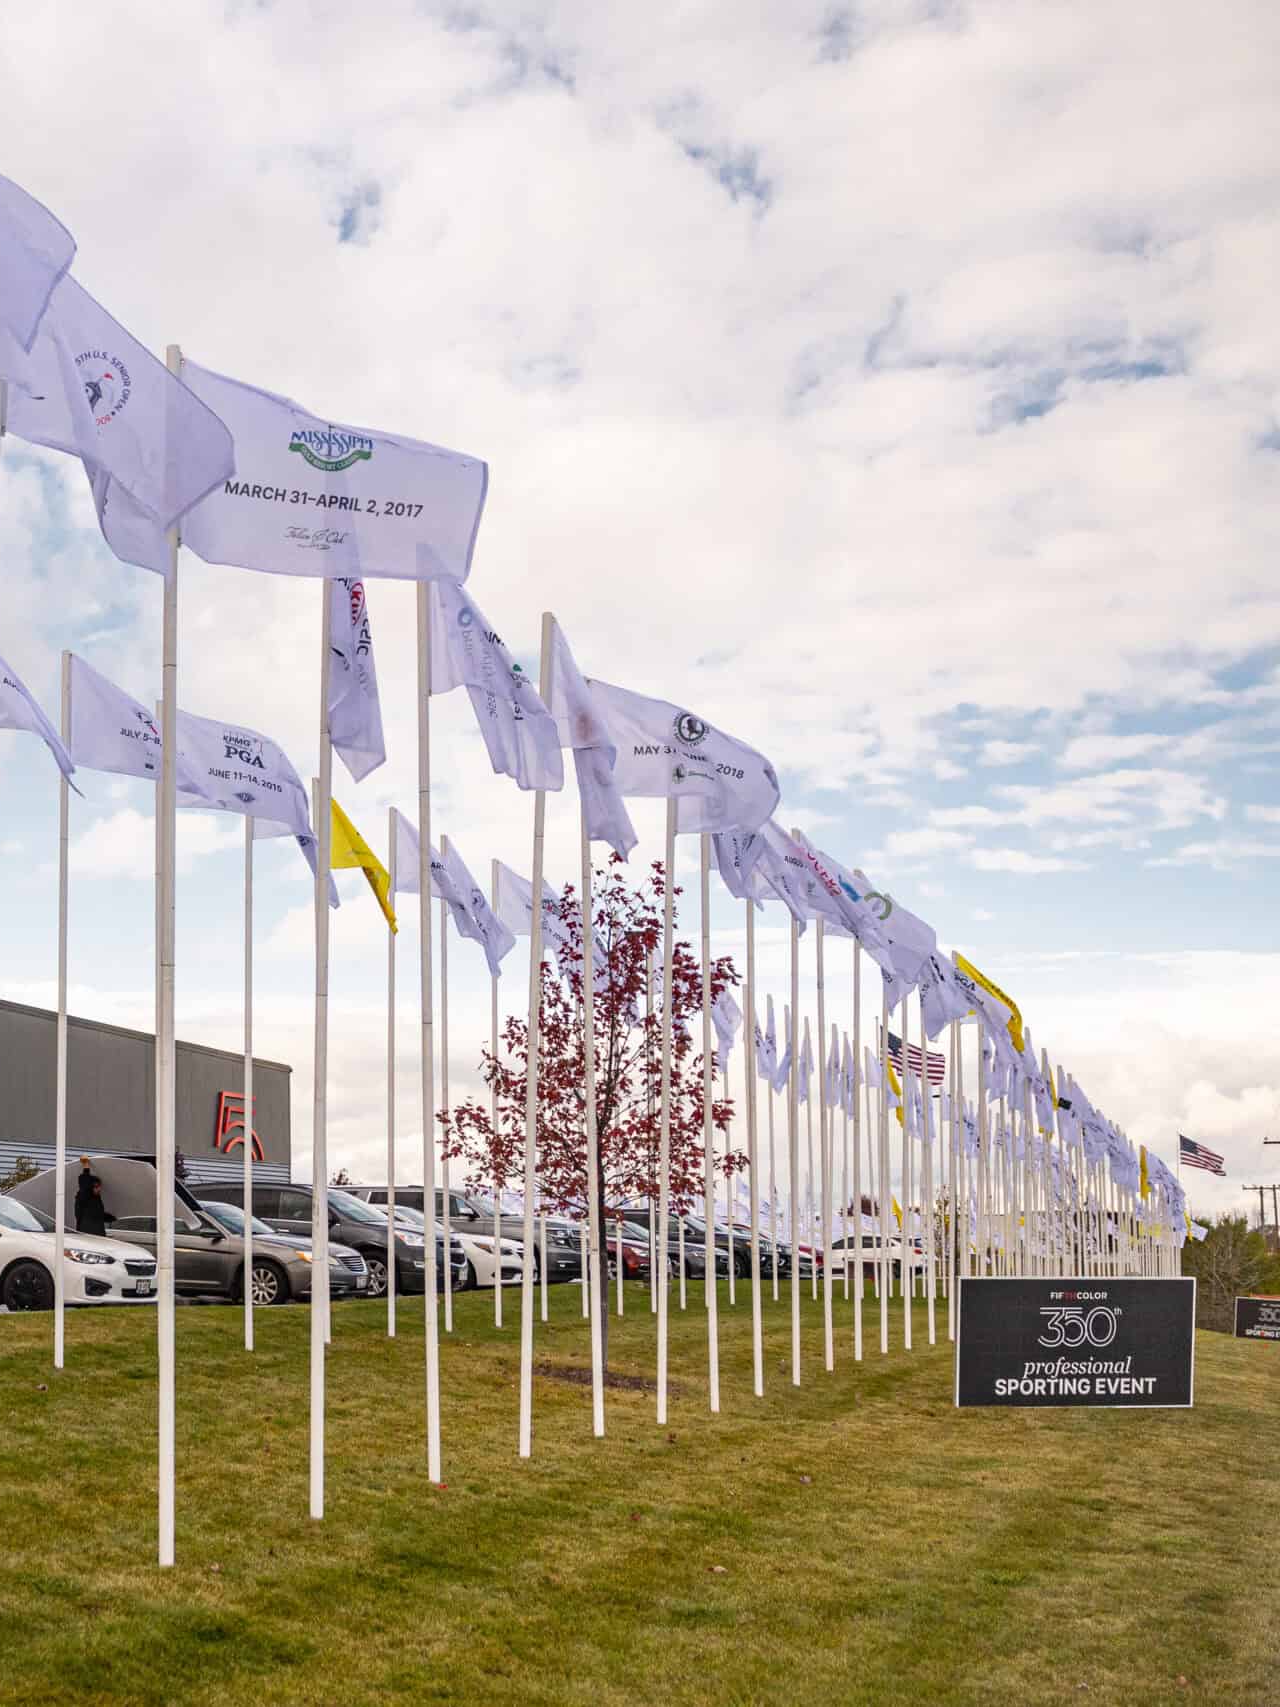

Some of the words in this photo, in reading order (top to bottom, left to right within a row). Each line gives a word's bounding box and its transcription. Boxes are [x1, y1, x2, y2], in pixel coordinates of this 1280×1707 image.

[110, 357, 131, 387] SENIOR
[114, 388, 131, 412] OPEN
[291, 430, 374, 454] MISSISSIPPI
[224, 480, 287, 502] MARCH
[366, 499, 380, 517] 2,
[383, 502, 424, 518] 2017
[120, 727, 141, 740] JULY
[223, 735, 251, 747] KPMG
[224, 744, 266, 769] PGA
[633, 745, 660, 756] MAY
[715, 763, 745, 779] 2018
[208, 767, 231, 780] JUNE
[1050, 1291, 1108, 1300] FIFTHCOLOR
[1023, 1356, 1132, 1379] professional
[995, 1377, 1091, 1396] SPORTING
[1095, 1377, 1157, 1395] EVENT
